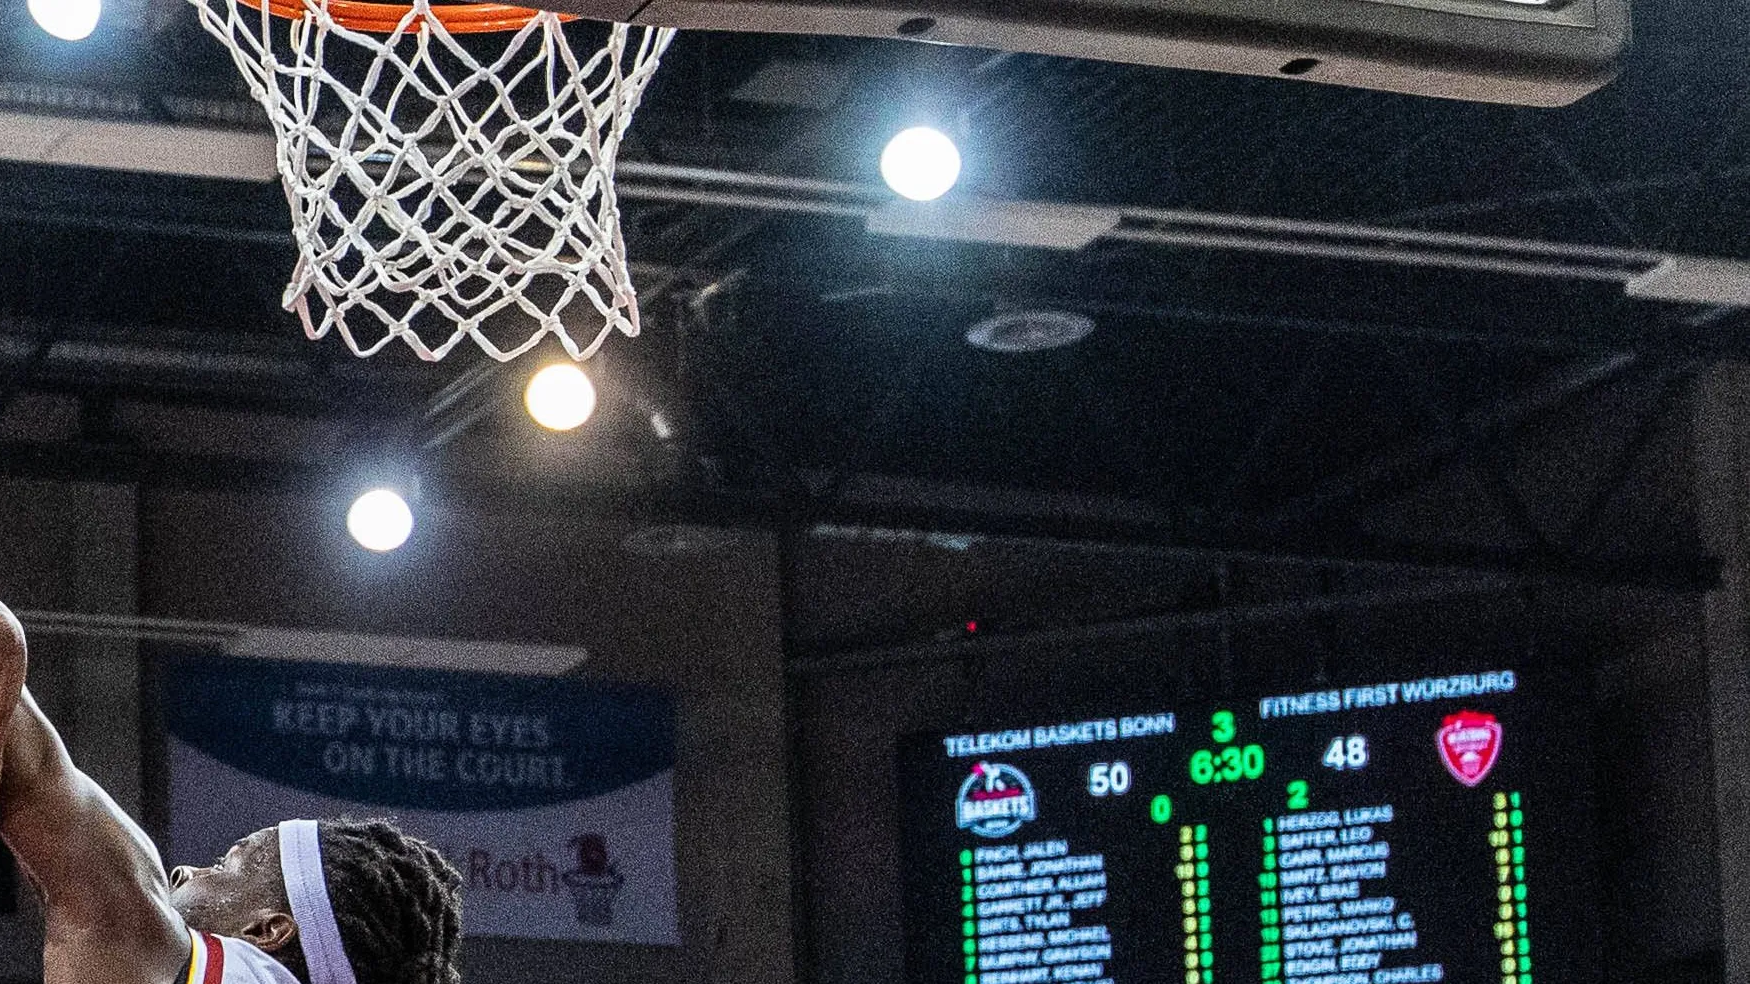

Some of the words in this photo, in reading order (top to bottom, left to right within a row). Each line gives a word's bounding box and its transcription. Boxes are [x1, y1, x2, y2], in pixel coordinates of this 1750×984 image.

[1259, 690, 1341, 719] FITNESS
[1342, 683, 1400, 710] FIRST
[1401, 670, 1517, 703] WÜRZBURG
[273, 702, 363, 736] KEEP
[368, 707, 459, 741] YOUR
[467, 713, 549, 748] EYES
[944, 729, 1031, 757] TELEKOM
[1032, 719, 1117, 748] BASKETS
[1118, 713, 1176, 738] BONN
[1211, 709, 1236, 744] 3
[324, 741, 379, 775] ON
[385, 745, 446, 781] THE
[456, 750, 570, 789] COURT
[1189, 744, 1265, 785] 6:30
[1323, 734, 1368, 770] 48
[1088, 761, 1130, 796] 50
[1286, 779, 1310, 809] 2
[1151, 794, 1172, 823] 0
[1344, 804, 1393, 825] LUKAS
